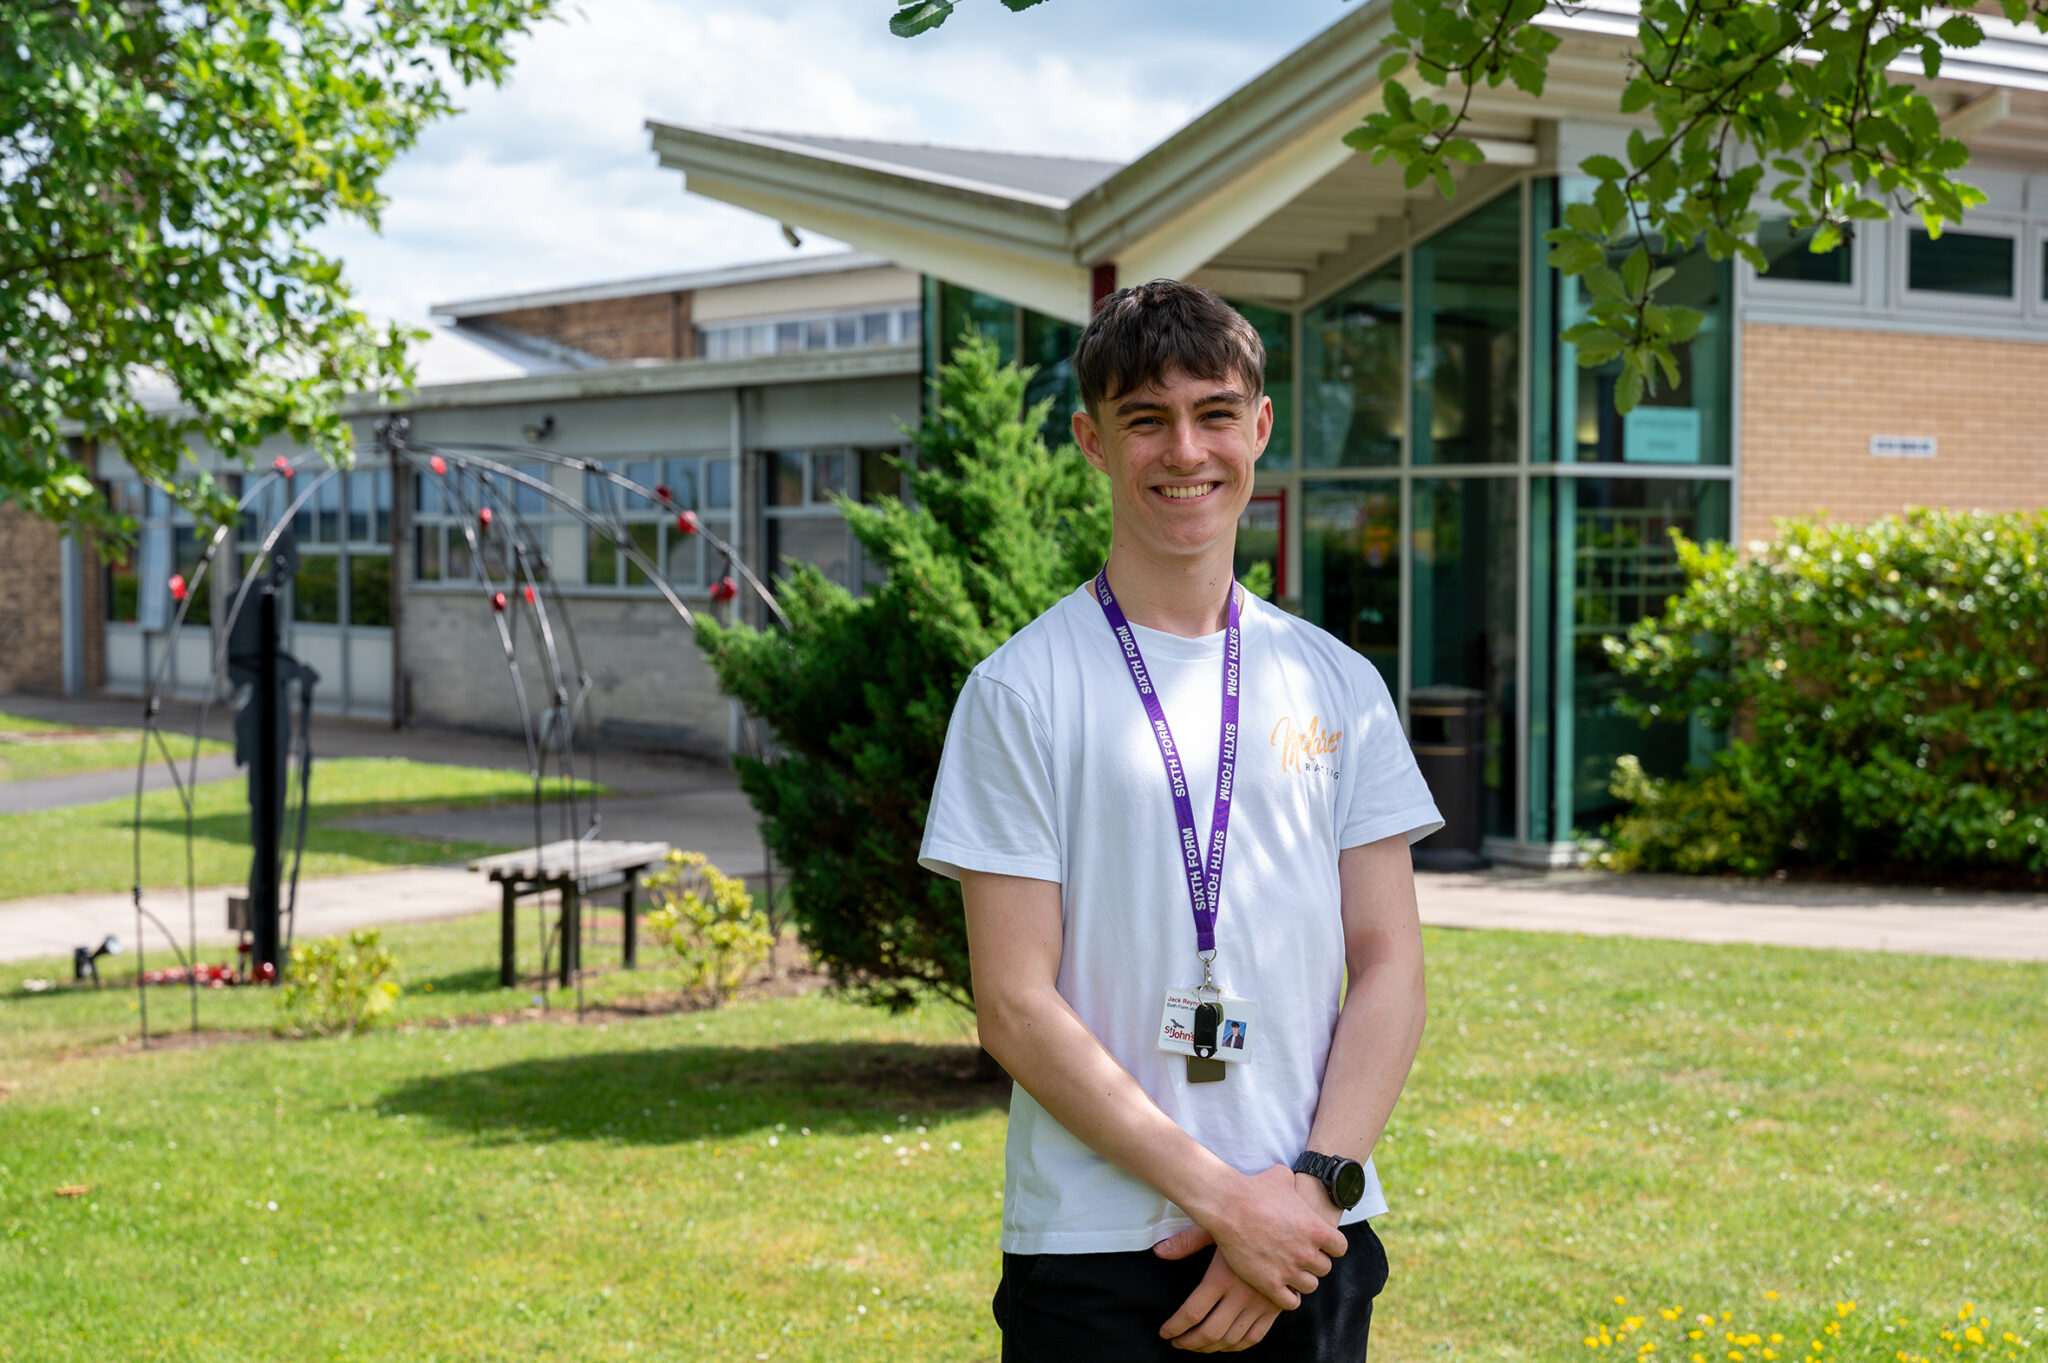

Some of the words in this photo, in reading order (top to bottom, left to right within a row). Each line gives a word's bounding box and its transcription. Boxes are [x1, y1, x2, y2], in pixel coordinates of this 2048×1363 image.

[1116, 625, 1138, 657] FORM
[1229, 626, 1239, 661] SIXTH
[1131, 660, 1152, 694] SIXTH
[1227, 662, 1238, 697] FORM
[1154, 720, 1176, 756] FORM
[1223, 723, 1236, 761] SIXTH
[1168, 757, 1186, 797] SIXTH
[1220, 762, 1234, 801] FORM
[1182, 828, 1198, 867] FORM
[1210, 830, 1225, 871] SIXTH
[1188, 872, 1206, 911] SIXTH
[1207, 873, 1220, 912] FORM
